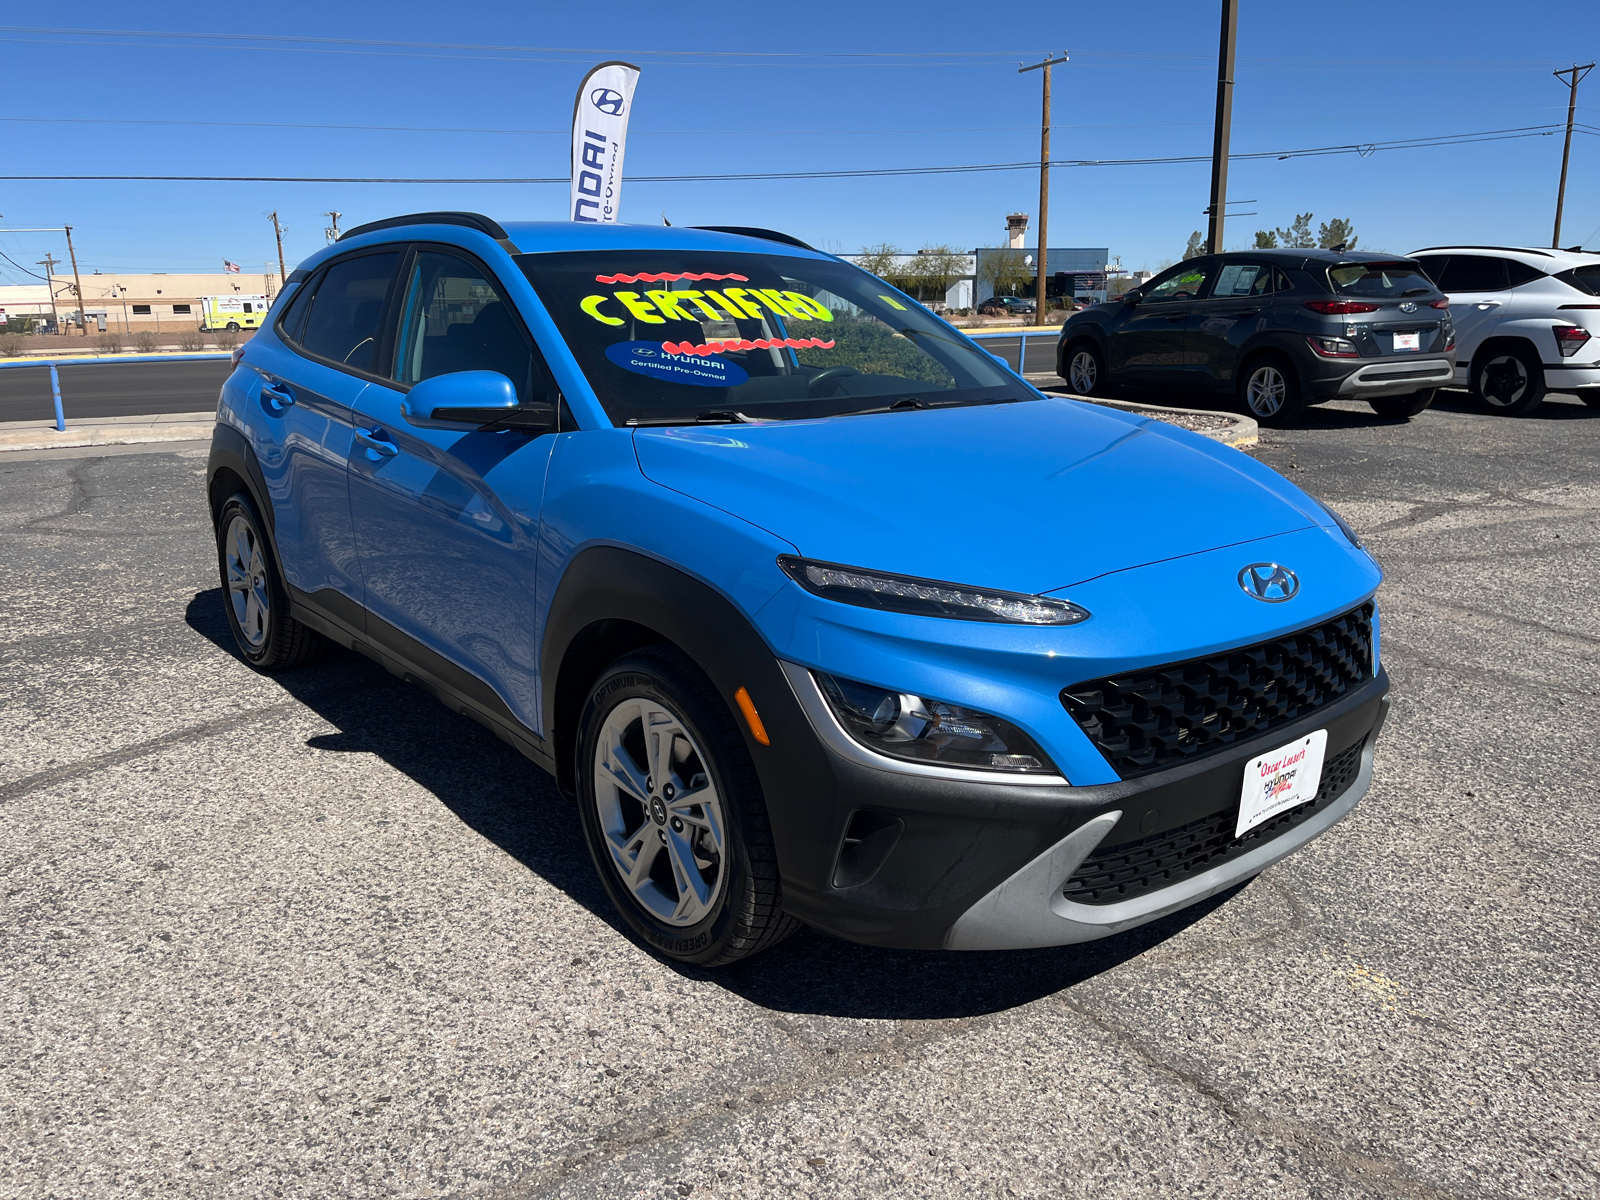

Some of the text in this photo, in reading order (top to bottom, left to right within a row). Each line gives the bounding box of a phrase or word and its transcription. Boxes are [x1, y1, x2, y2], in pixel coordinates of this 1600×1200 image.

[603, 142, 618, 222] re-Owned
[1105, 264, 1120, 272] 8515
[580, 288, 834, 326] CERTIFIED
[631, 360, 726, 380] Certified Pre-Owned
[661, 352, 725, 369] HYUNDAI
[595, 676, 635, 704] OPTIMUM
[1261, 760, 1282, 777] Oscar
[1263, 768, 1297, 790] HYUNDAI
[675, 931, 708, 951] GREEN
